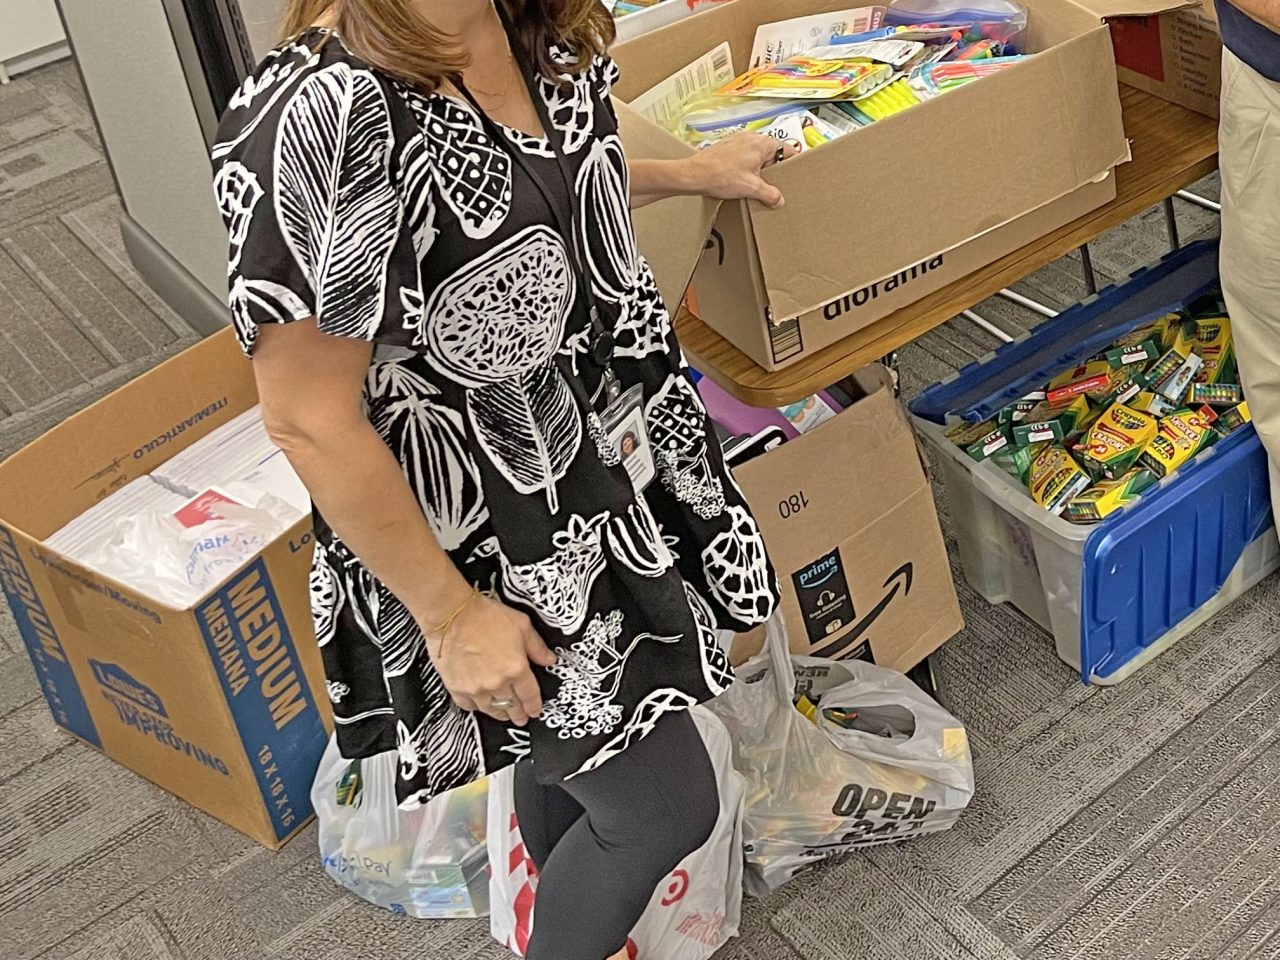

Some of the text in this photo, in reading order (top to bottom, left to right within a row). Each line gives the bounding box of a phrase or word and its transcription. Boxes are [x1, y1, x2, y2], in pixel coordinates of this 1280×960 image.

[1115, 407, 1146, 426] Crayola
[1091, 431, 1126, 452] CRAYONS
[778, 490, 810, 519] 180
[799, 555, 837, 586] prime
[202, 598, 251, 698] MEDIANA
[226, 568, 309, 732] MEDIUM
[116, 698, 229, 776] IMPROVING
[257, 744, 273, 766] 18
[269, 777, 285, 797] 18
[832, 783, 937, 821] OPEN
